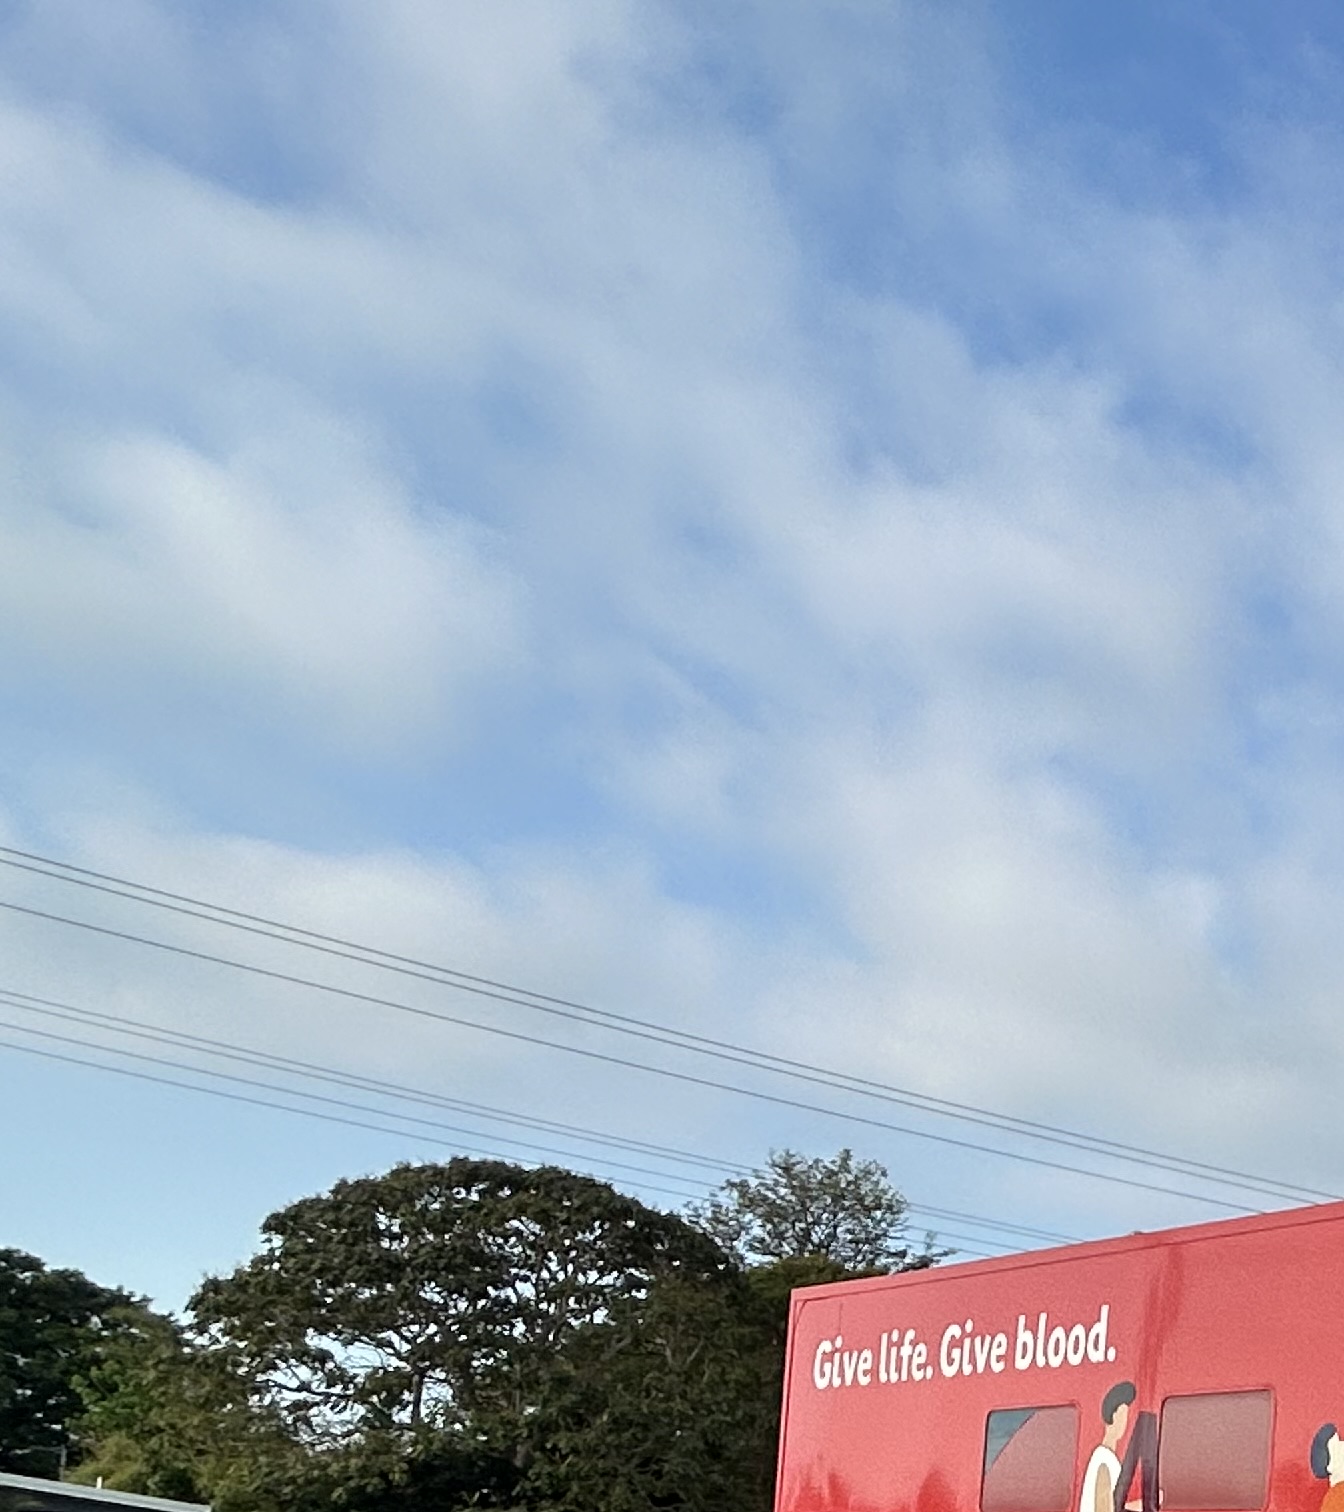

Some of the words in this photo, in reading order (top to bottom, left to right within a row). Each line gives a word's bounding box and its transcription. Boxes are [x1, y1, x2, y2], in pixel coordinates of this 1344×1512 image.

[813, 1335, 872, 1389] Give
[879, 1328, 933, 1384] life.
[940, 1318, 1008, 1378] Give
[1014, 1304, 1116, 1371] blood.
